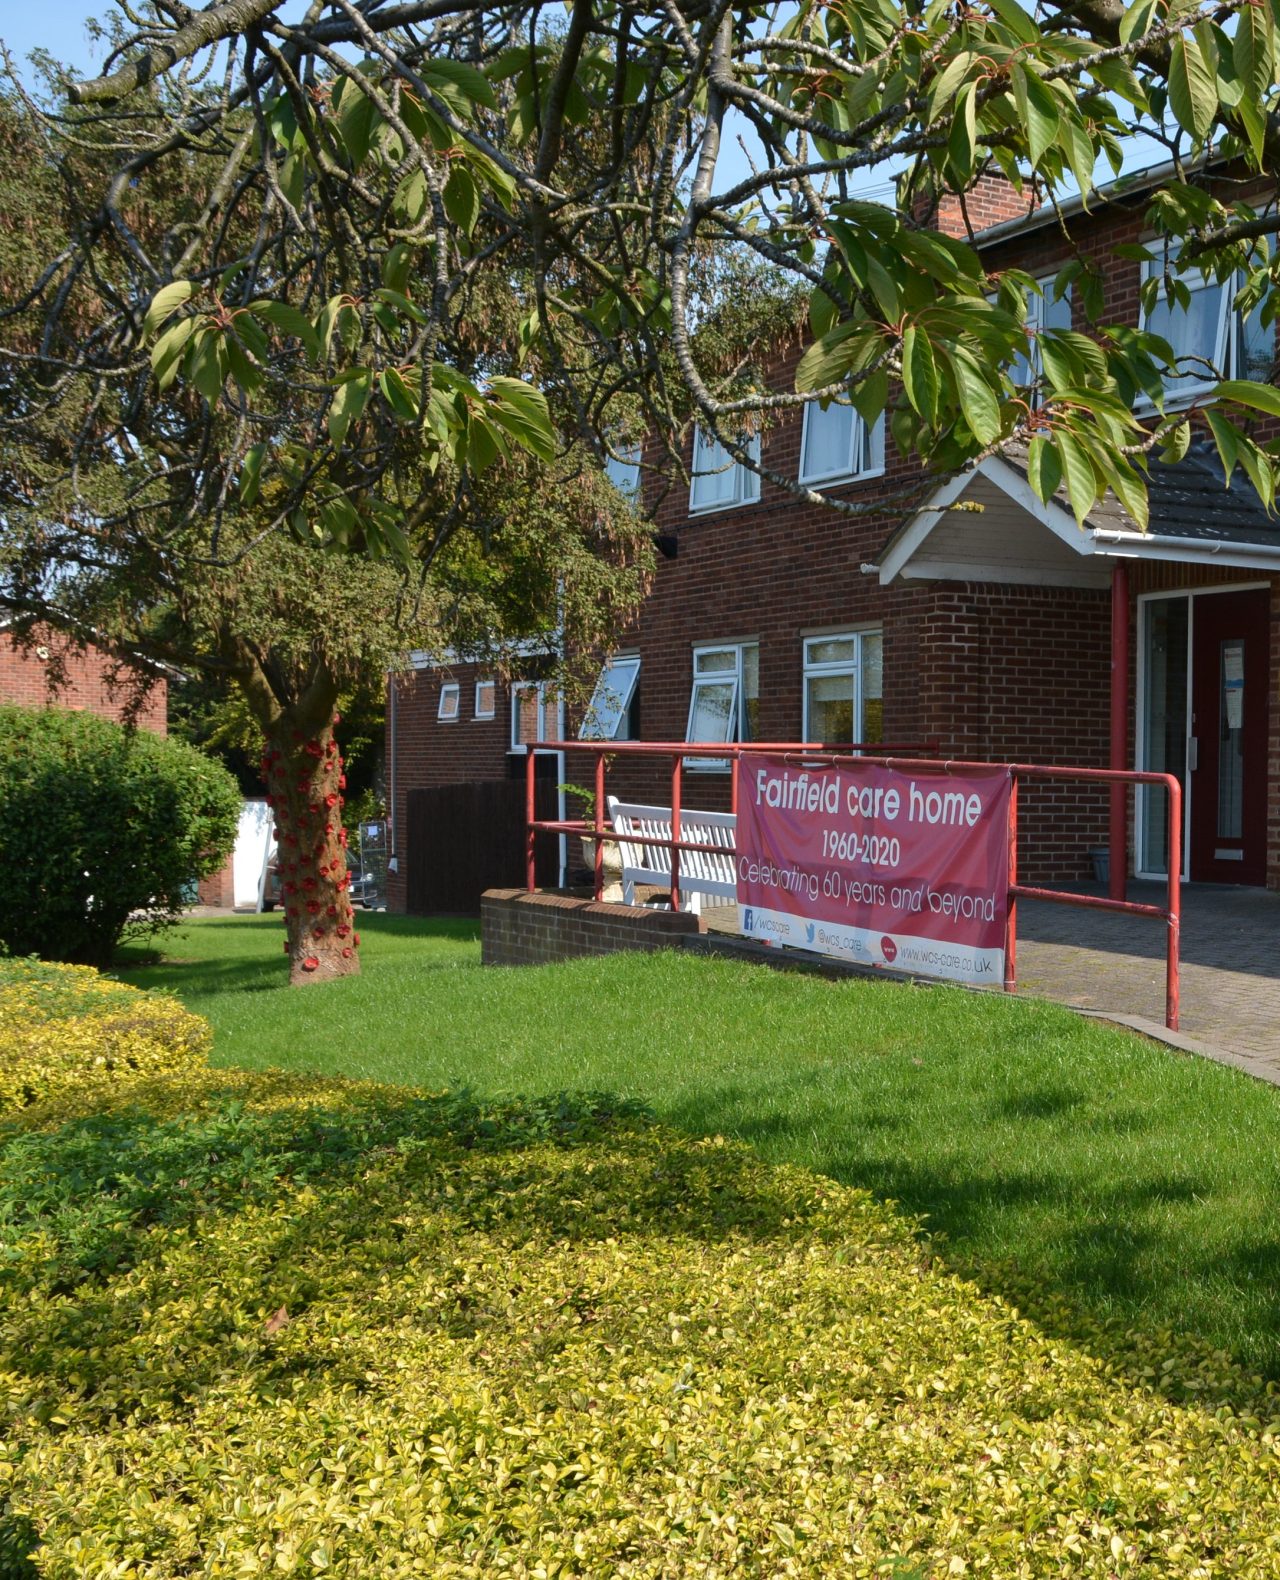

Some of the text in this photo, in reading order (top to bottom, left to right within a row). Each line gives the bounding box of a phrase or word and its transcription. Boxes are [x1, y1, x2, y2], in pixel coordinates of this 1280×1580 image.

[756, 769, 982, 826] Fairfield care home
[822, 829, 900, 867] 1960-2020
[739, 856, 995, 923] Celebrating 60 years and beyond
[900, 947, 993, 974] www.wcs-care.co.uk
